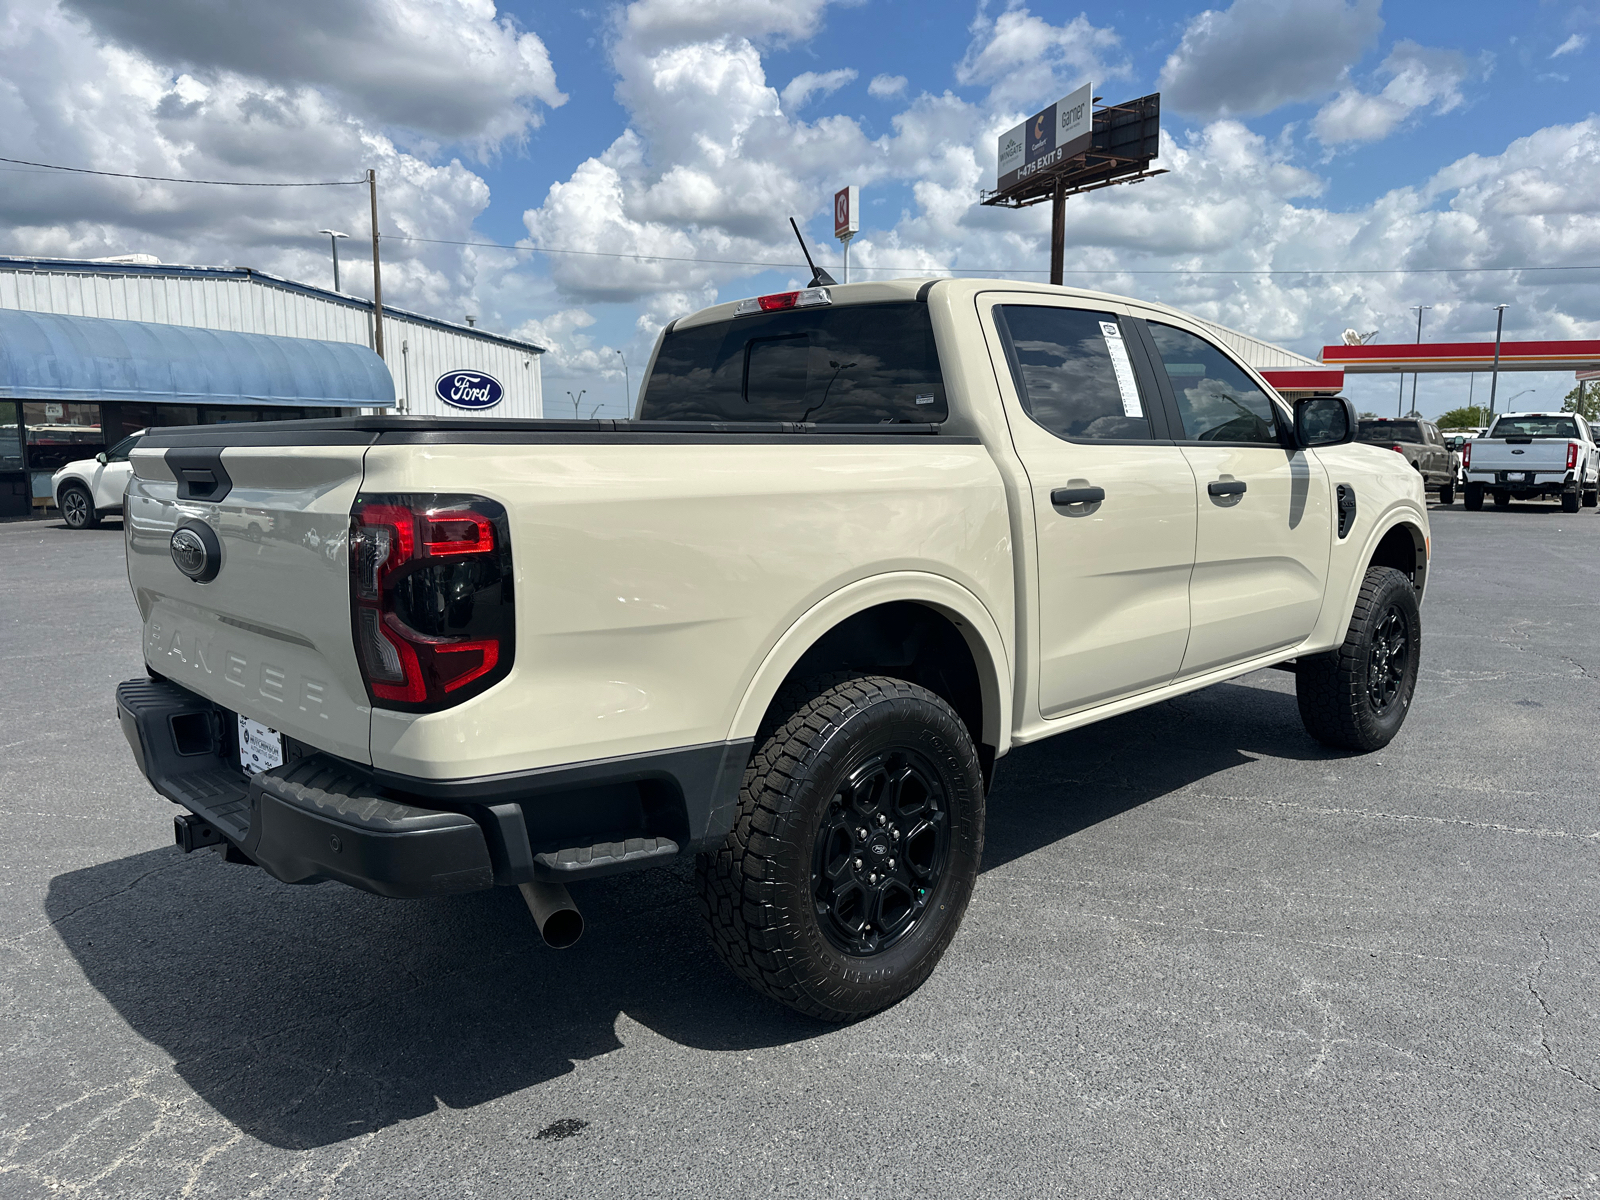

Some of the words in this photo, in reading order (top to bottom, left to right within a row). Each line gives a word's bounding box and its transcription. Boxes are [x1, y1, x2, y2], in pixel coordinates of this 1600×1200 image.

[1062, 102, 1085, 128] Garner
[1000, 143, 1022, 161] WINGATE
[1017, 161, 1036, 180] I-475
[1037, 150, 1056, 170] EXIT
[1056, 147, 1063, 160] 9
[451, 375, 490, 401] Ford
[919, 729, 959, 770] TOYO
